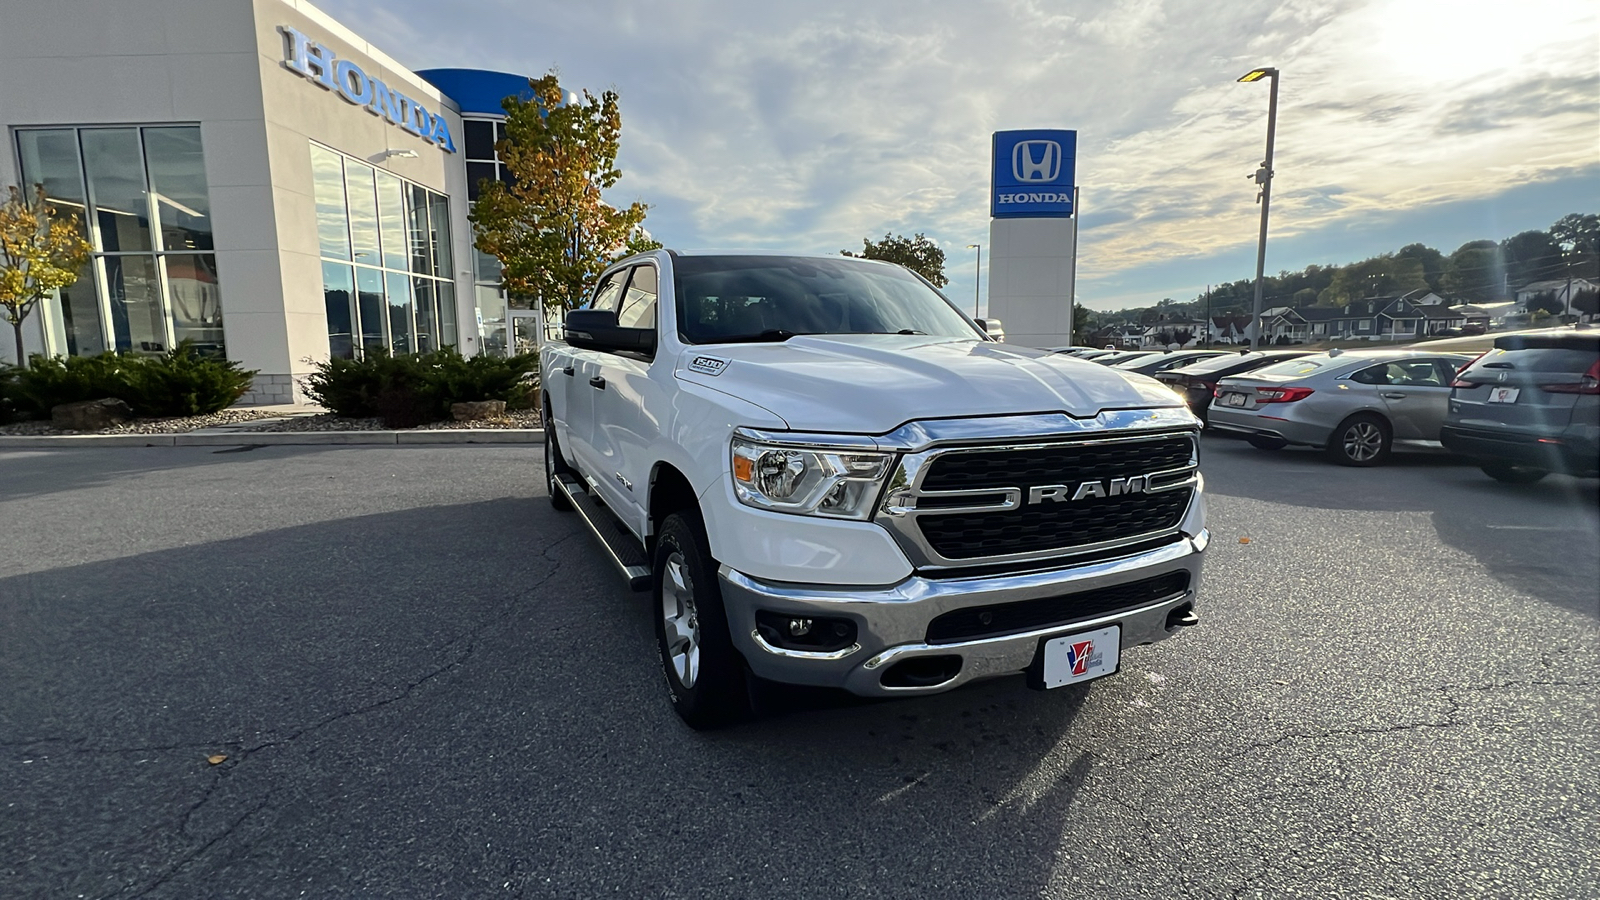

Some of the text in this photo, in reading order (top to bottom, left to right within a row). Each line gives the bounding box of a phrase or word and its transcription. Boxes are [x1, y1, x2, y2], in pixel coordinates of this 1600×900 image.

[281, 25, 456, 153] HONDA
[998, 193, 1071, 204] HONDA
[695, 358, 722, 369] 1500
[1028, 475, 1143, 505] RAM
